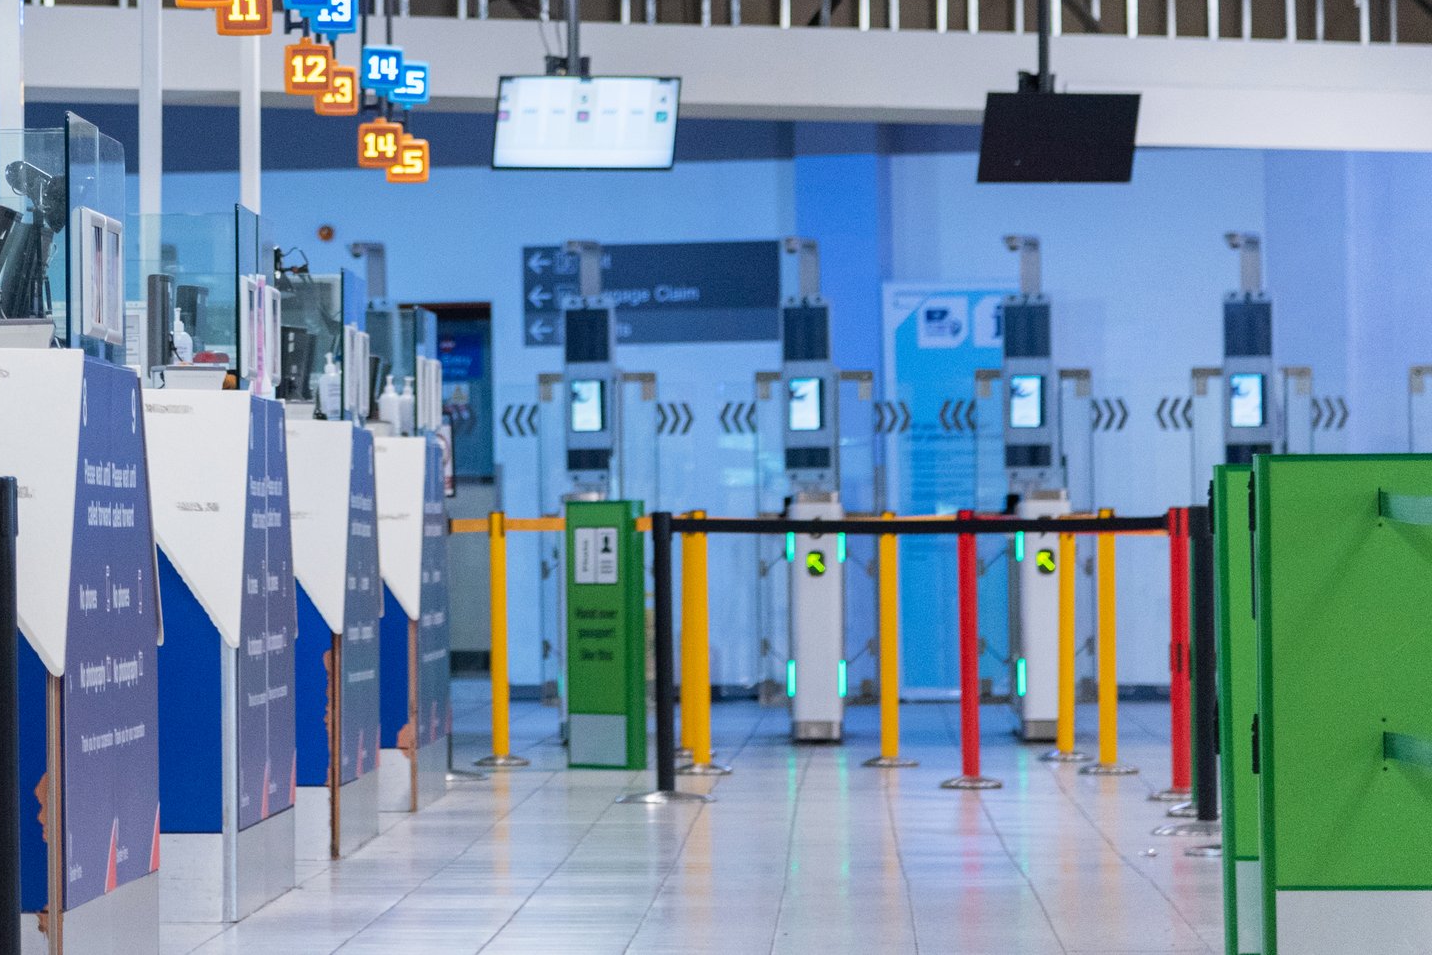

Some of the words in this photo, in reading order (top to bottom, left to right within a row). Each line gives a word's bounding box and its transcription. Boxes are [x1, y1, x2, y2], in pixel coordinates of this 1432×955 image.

[291, 55, 327, 83] 12
[368, 55, 399, 81] 14
[394, 69, 425, 94] 5
[363, 133, 397, 158] 14
[391, 149, 423, 174] 5
[83, 378, 88, 427] 8
[131, 388, 136, 434] 9
